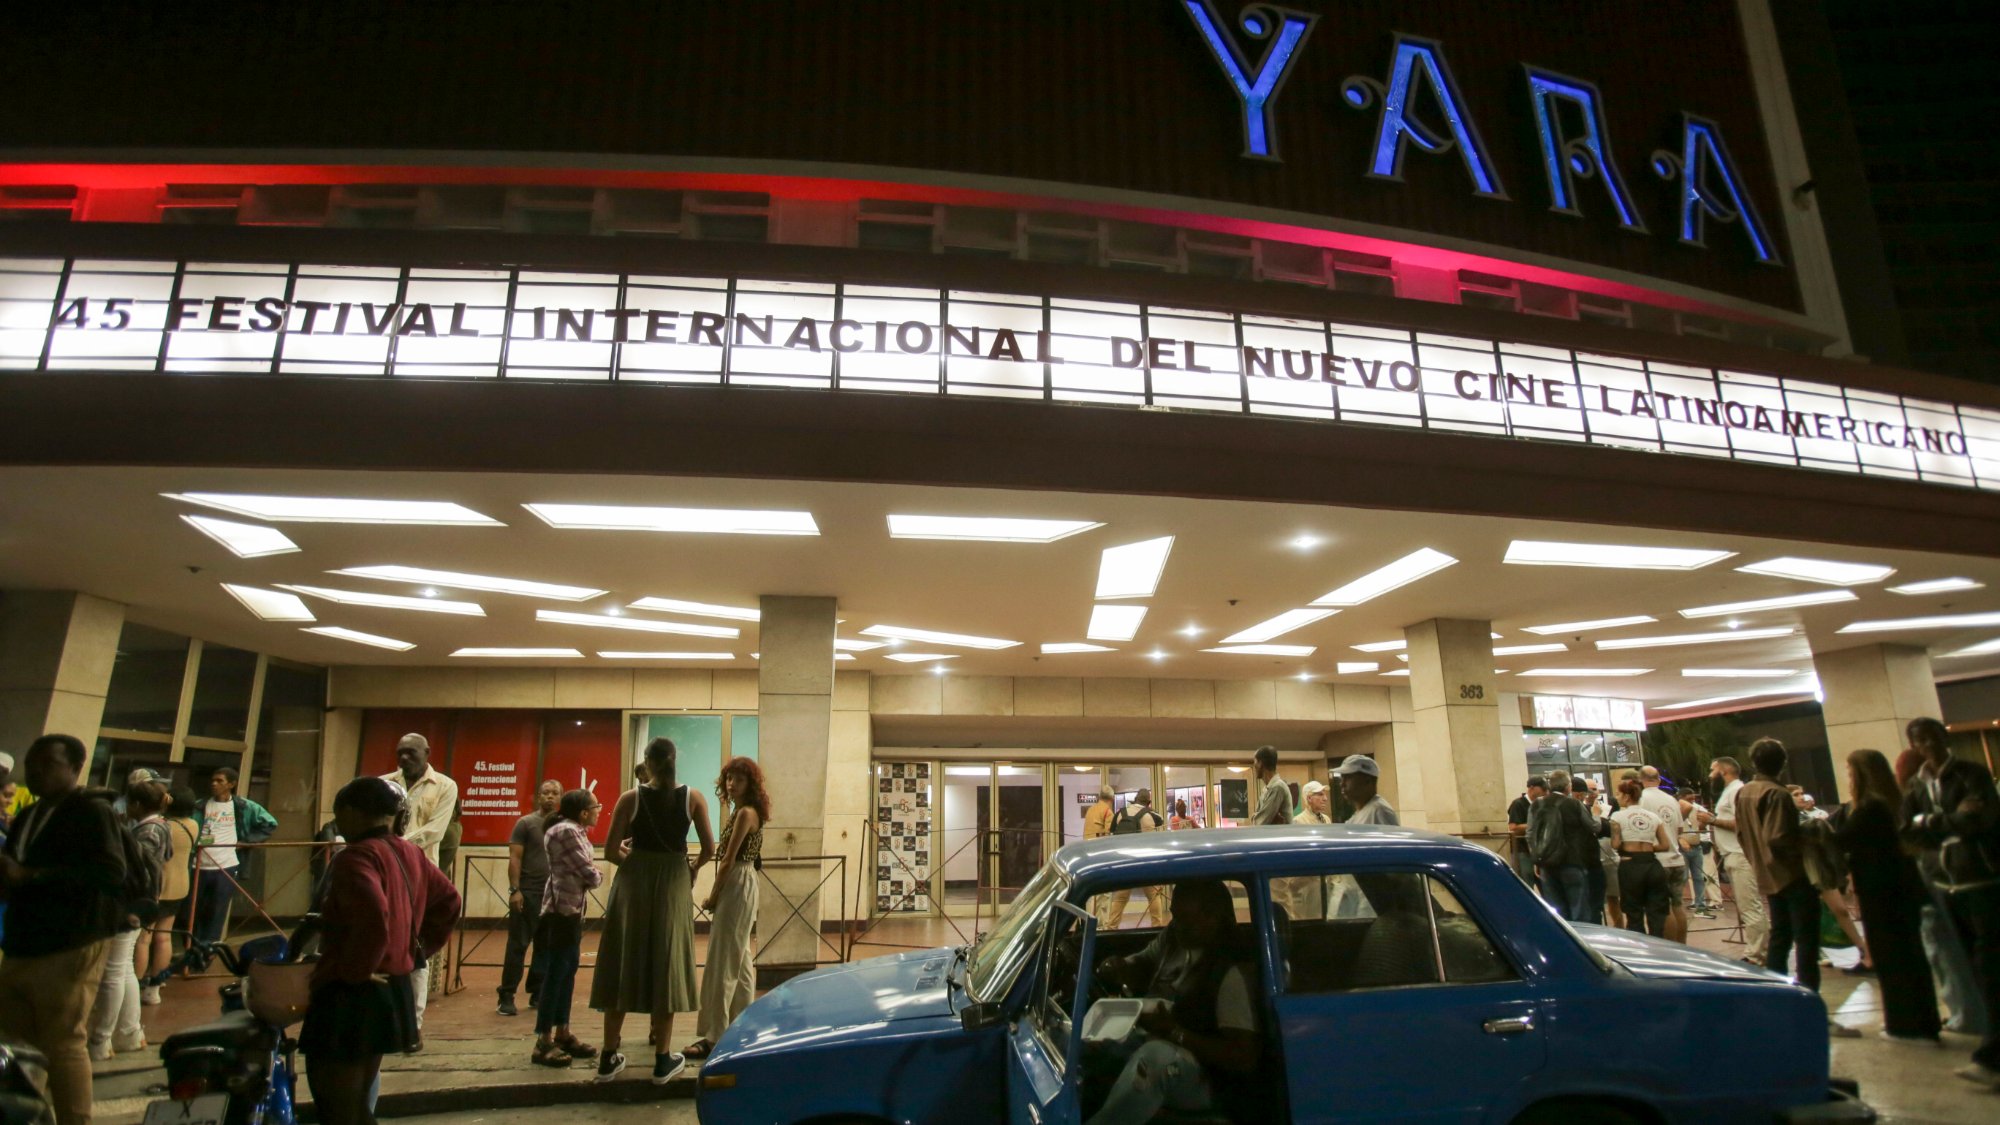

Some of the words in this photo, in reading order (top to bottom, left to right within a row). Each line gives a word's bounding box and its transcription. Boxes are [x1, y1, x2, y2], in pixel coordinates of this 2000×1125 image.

[1182, 0, 1783, 266] YARA
[56, 297, 135, 330] 45
[166, 296, 480, 337] FESTIVAL
[534, 306, 1064, 364] INTERNACIONAL
[1111, 336, 1211, 374] DEL
[1243, 346, 1420, 393] NUEVO
[1454, 370, 1568, 408] CINE
[1600, 384, 1967, 456] LATINOAMERICANO
[1460, 684, 1484, 699] 363
[475, 761, 487, 771] 45.
[489, 763, 515, 771] Festival
[471, 775, 517, 783] Internacional
[501, 787, 517, 795] Cine
[462, 799, 519, 807] Latinoamericano
